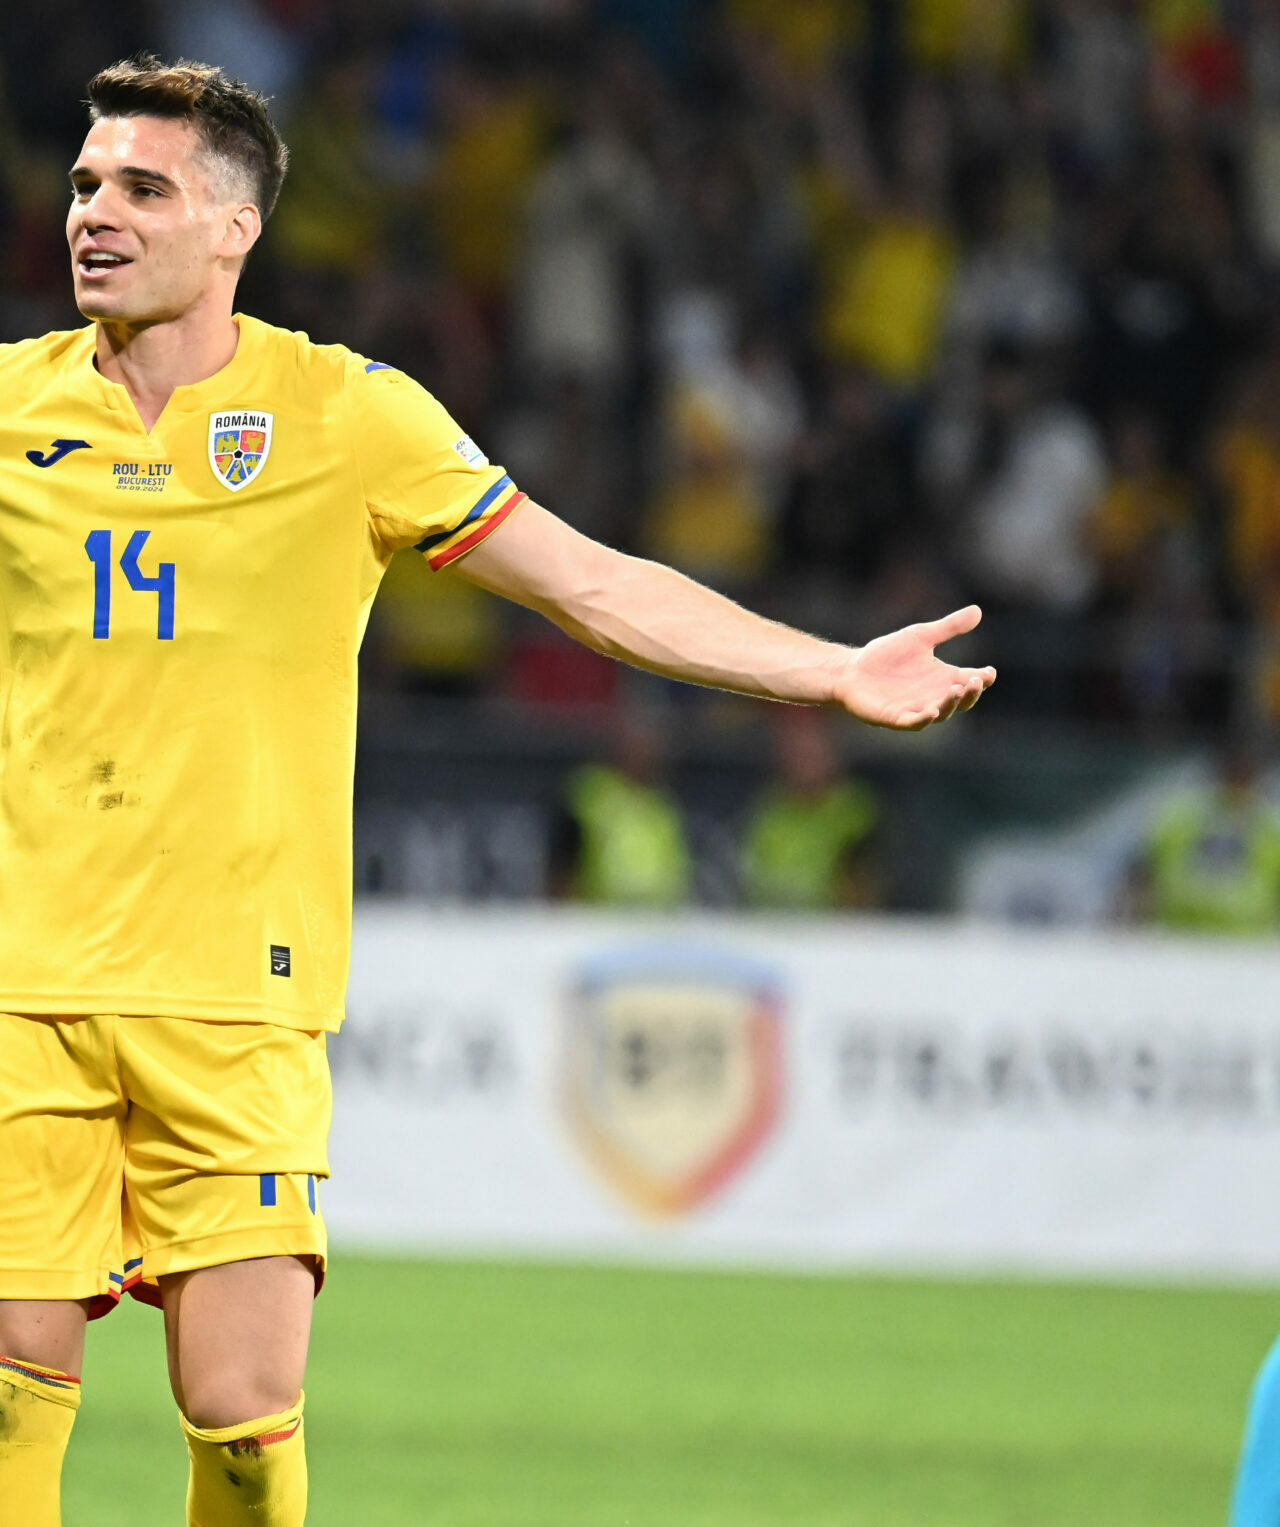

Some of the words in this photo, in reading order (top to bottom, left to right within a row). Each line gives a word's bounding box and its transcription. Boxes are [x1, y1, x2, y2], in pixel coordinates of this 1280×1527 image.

[215, 413, 266, 428] ROMÂNIA
[113, 463, 138, 475] ROU
[148, 463, 173, 476] LTU
[84, 530, 175, 640] 14
